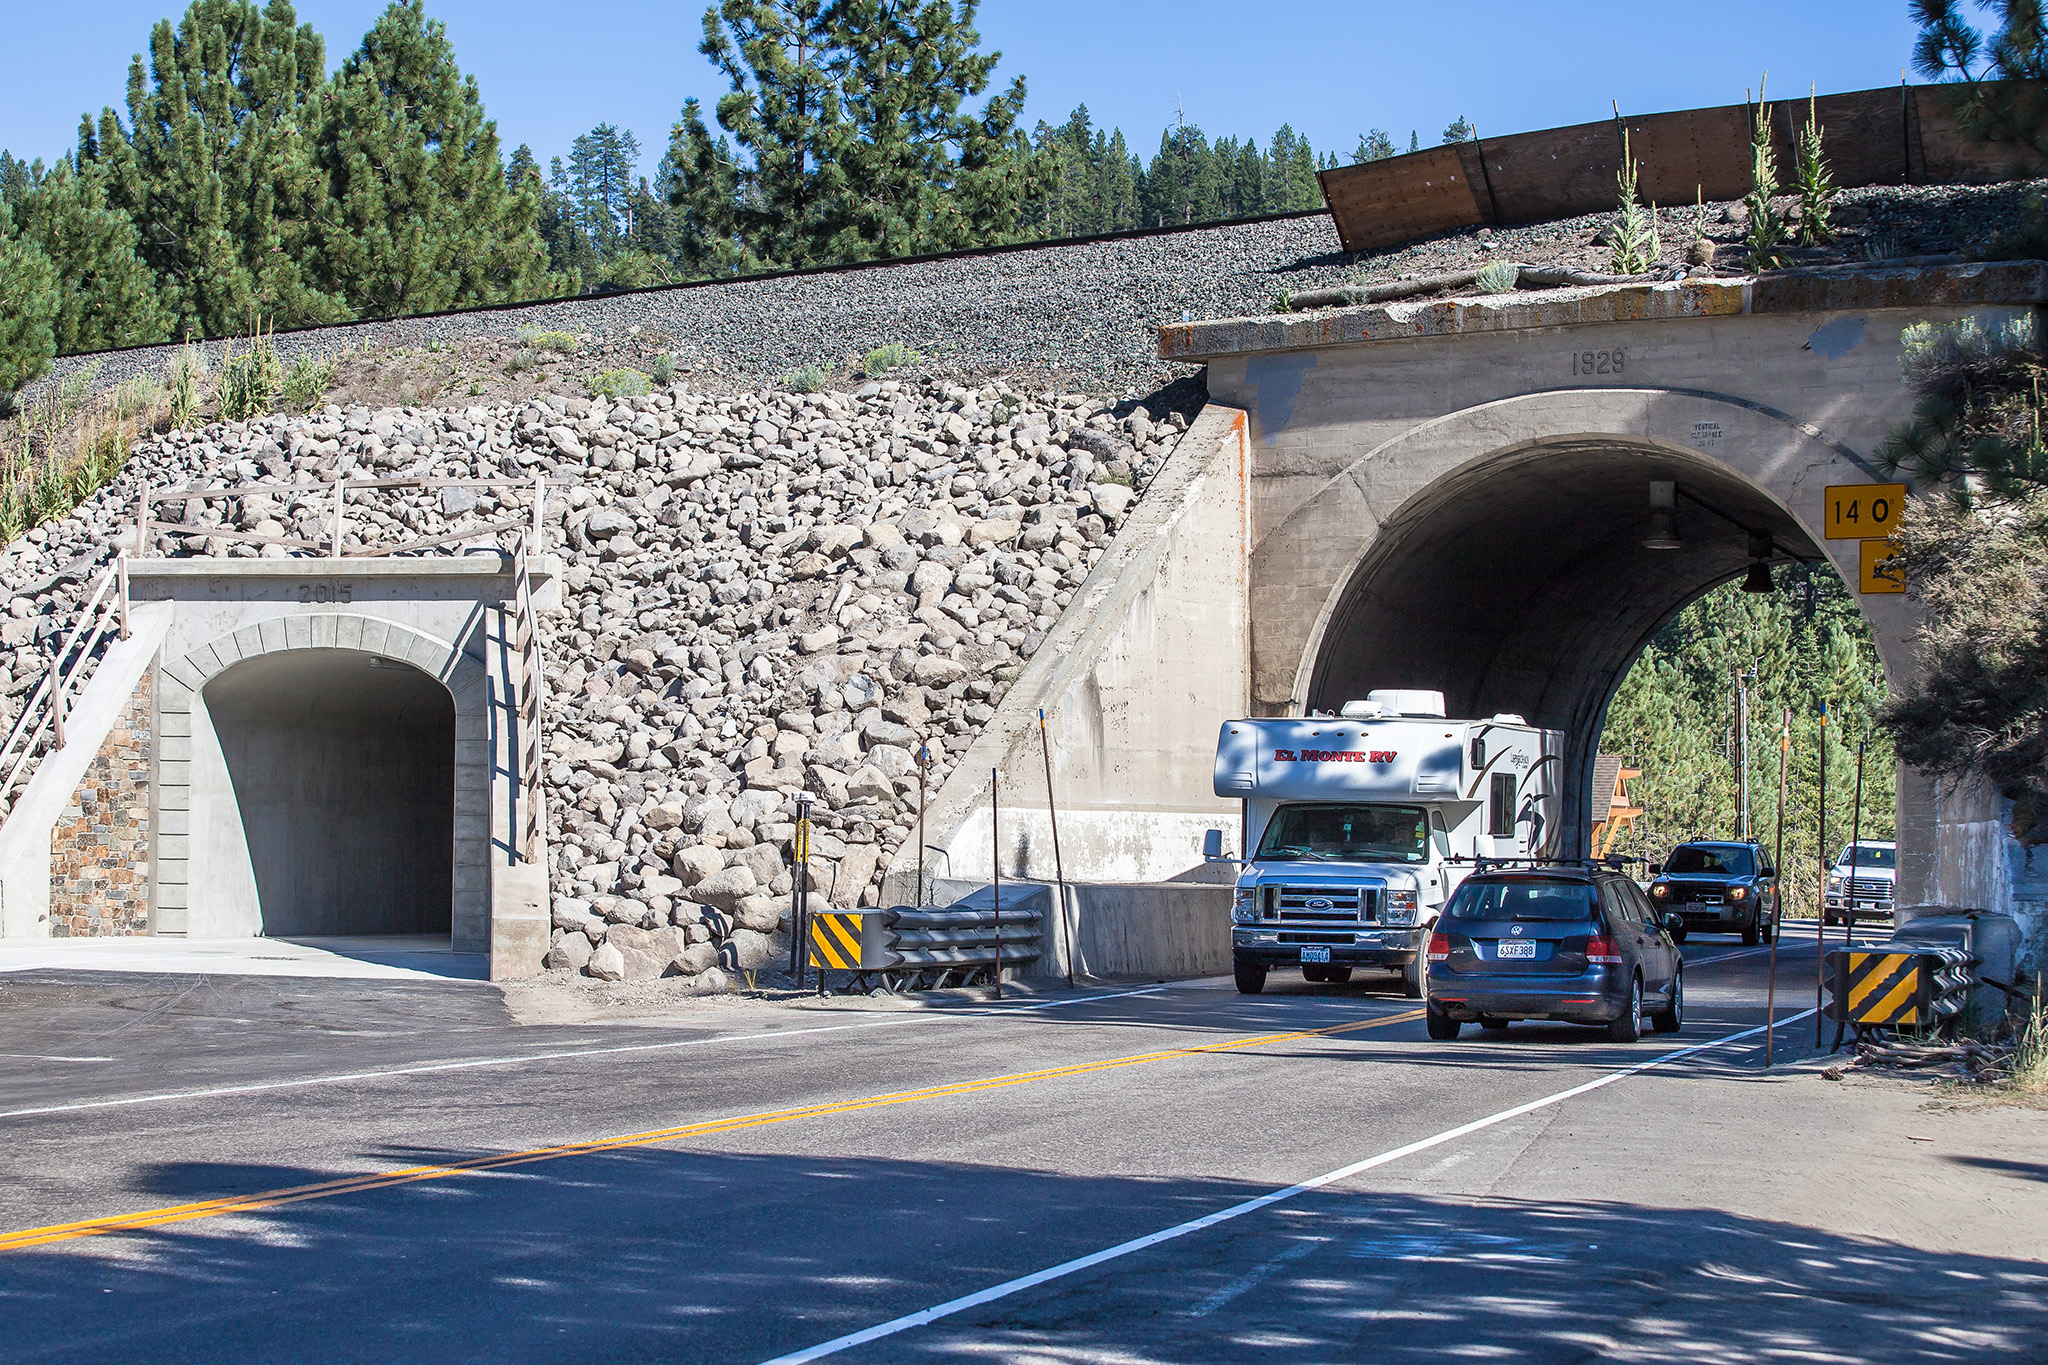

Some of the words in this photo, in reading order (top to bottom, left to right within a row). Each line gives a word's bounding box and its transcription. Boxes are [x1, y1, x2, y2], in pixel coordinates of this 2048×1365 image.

[1572, 350, 1625, 376] 1929
[1694, 422, 1720, 431] VERTICAL
[299, 584, 352, 603] 2015
[1274, 749, 1298, 762] EL
[1299, 749, 1366, 762] MONTE
[1368, 750, 1398, 763] RV
[1500, 945, 1534, 955] 6SXF388
